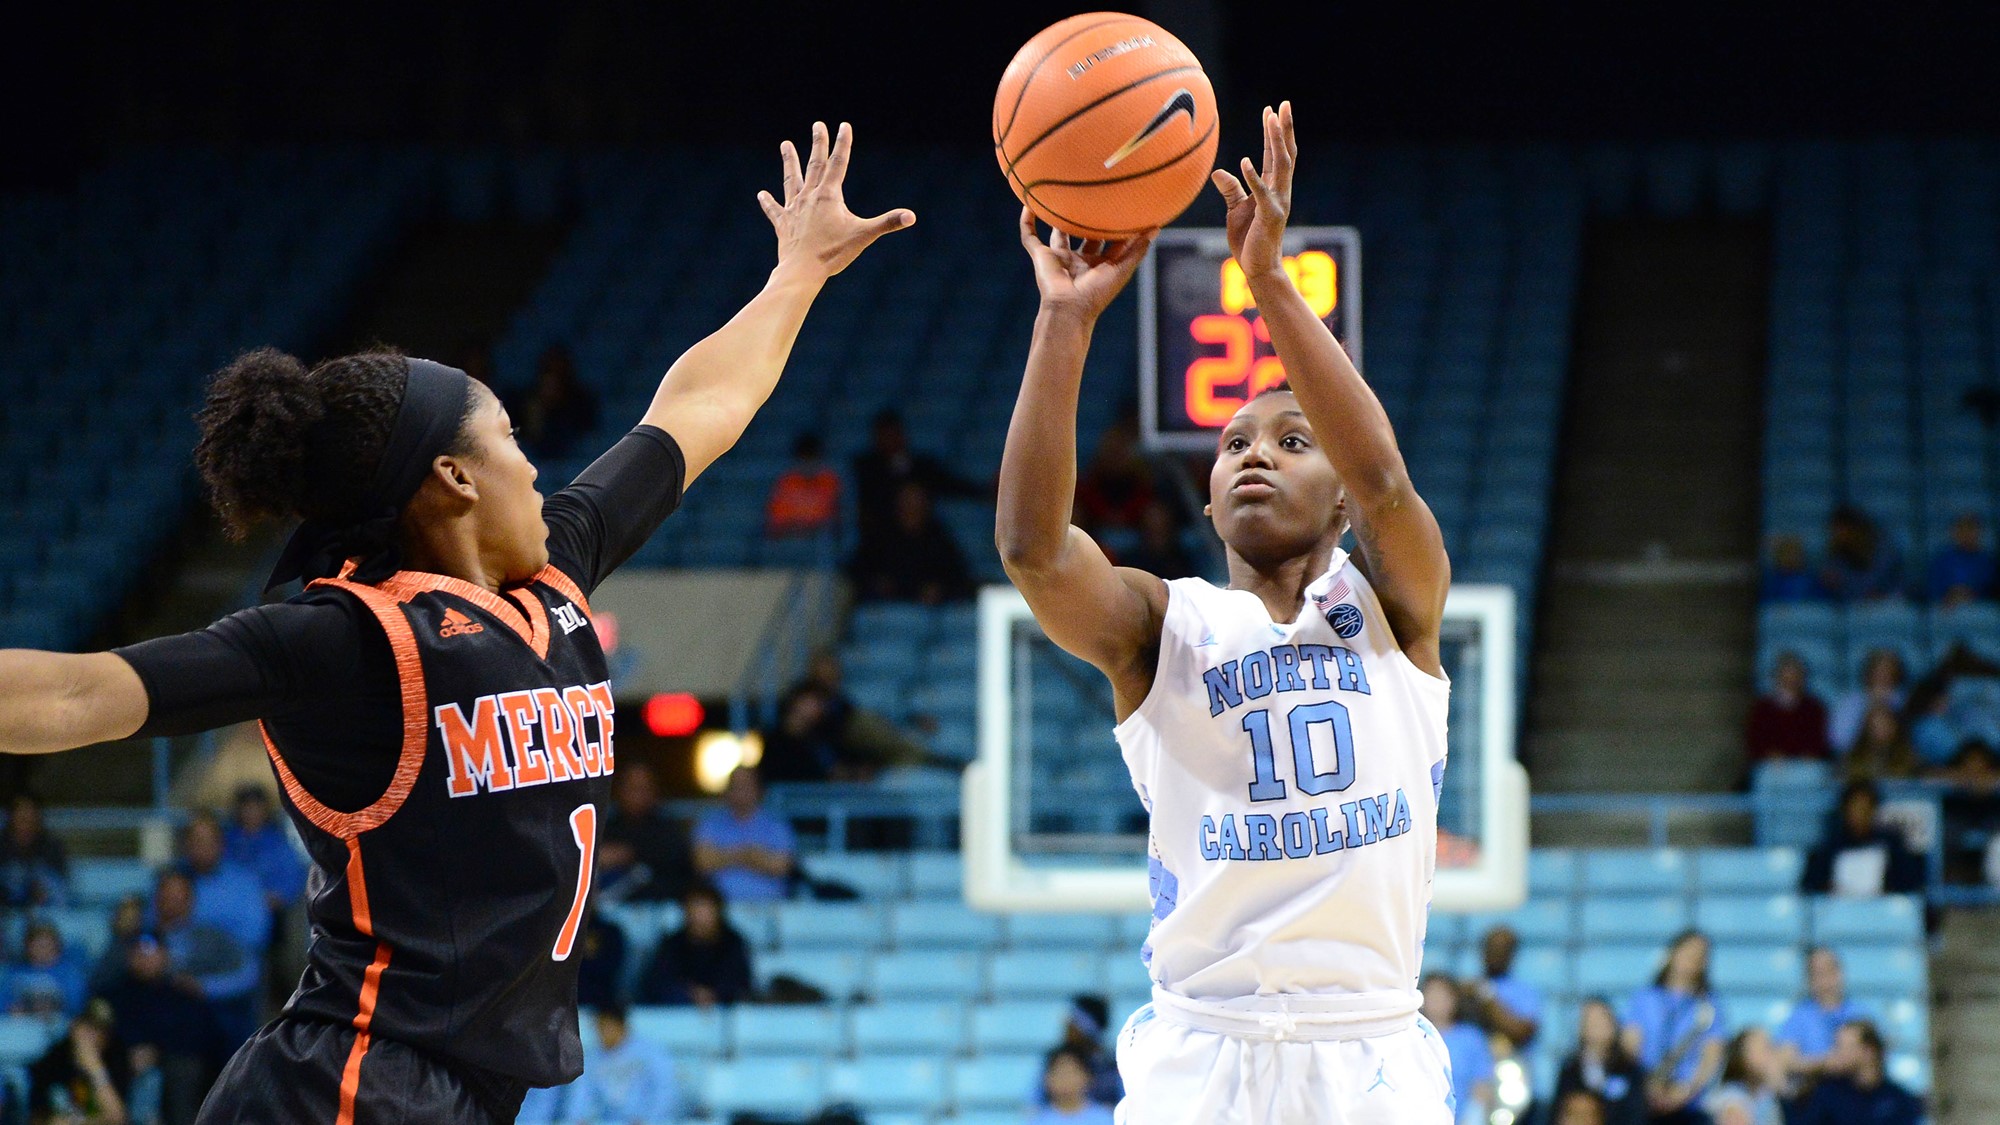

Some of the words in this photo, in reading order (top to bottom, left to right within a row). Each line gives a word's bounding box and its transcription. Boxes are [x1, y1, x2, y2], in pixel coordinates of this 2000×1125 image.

[1334, 609, 1357, 627] ACC
[1202, 643, 1372, 718] NORTH
[1241, 700, 1356, 803] 10
[1199, 788, 1412, 861] CAROLINA
[551, 803, 597, 962] 1
